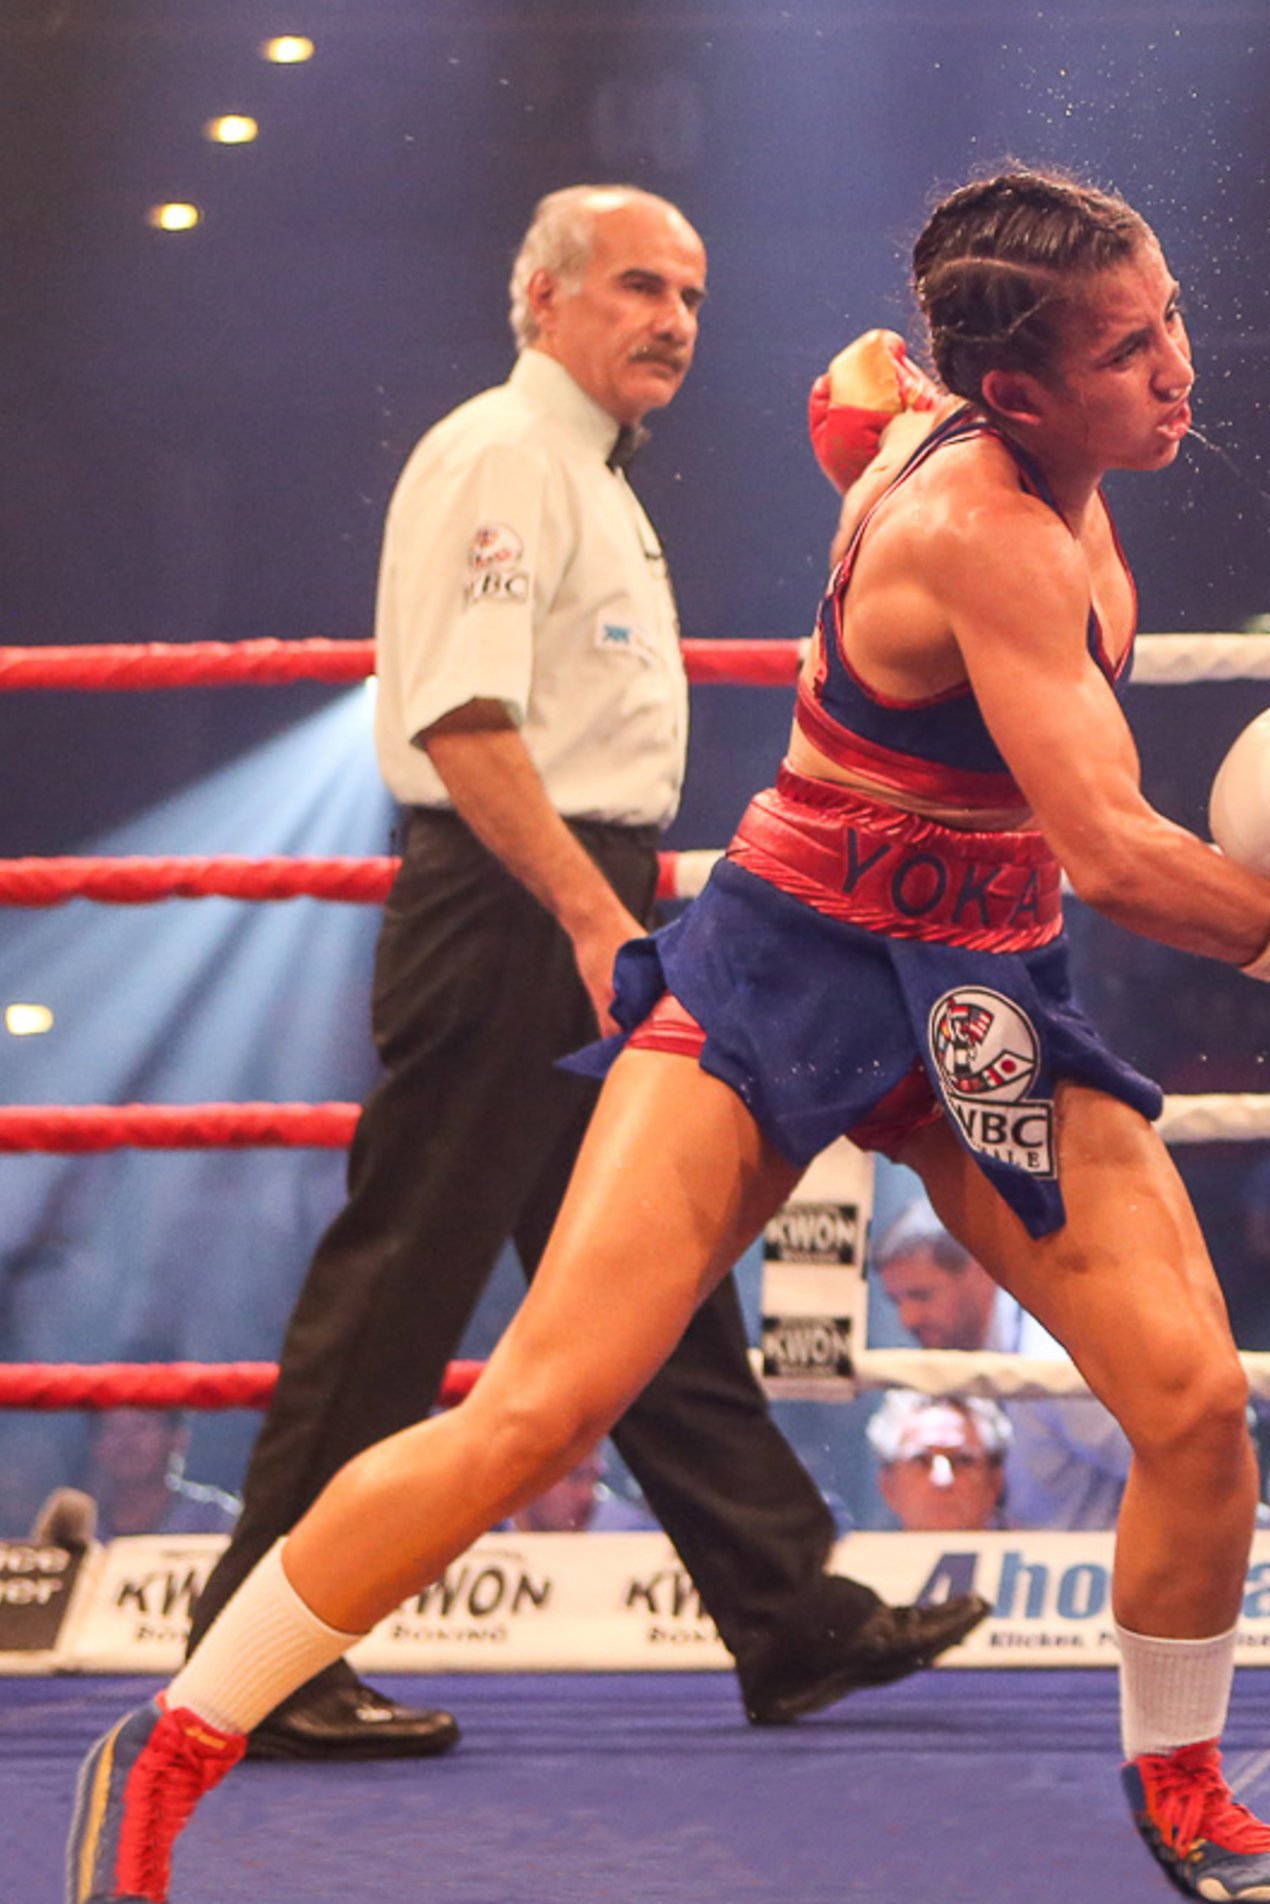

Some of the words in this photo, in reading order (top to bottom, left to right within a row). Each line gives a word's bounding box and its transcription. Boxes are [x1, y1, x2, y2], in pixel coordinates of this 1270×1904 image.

[842, 826, 1041, 926] YOKA
[766, 1214, 857, 1250] KWON
[764, 1326, 851, 1363] KWON
[410, 1565, 552, 1618] WON
